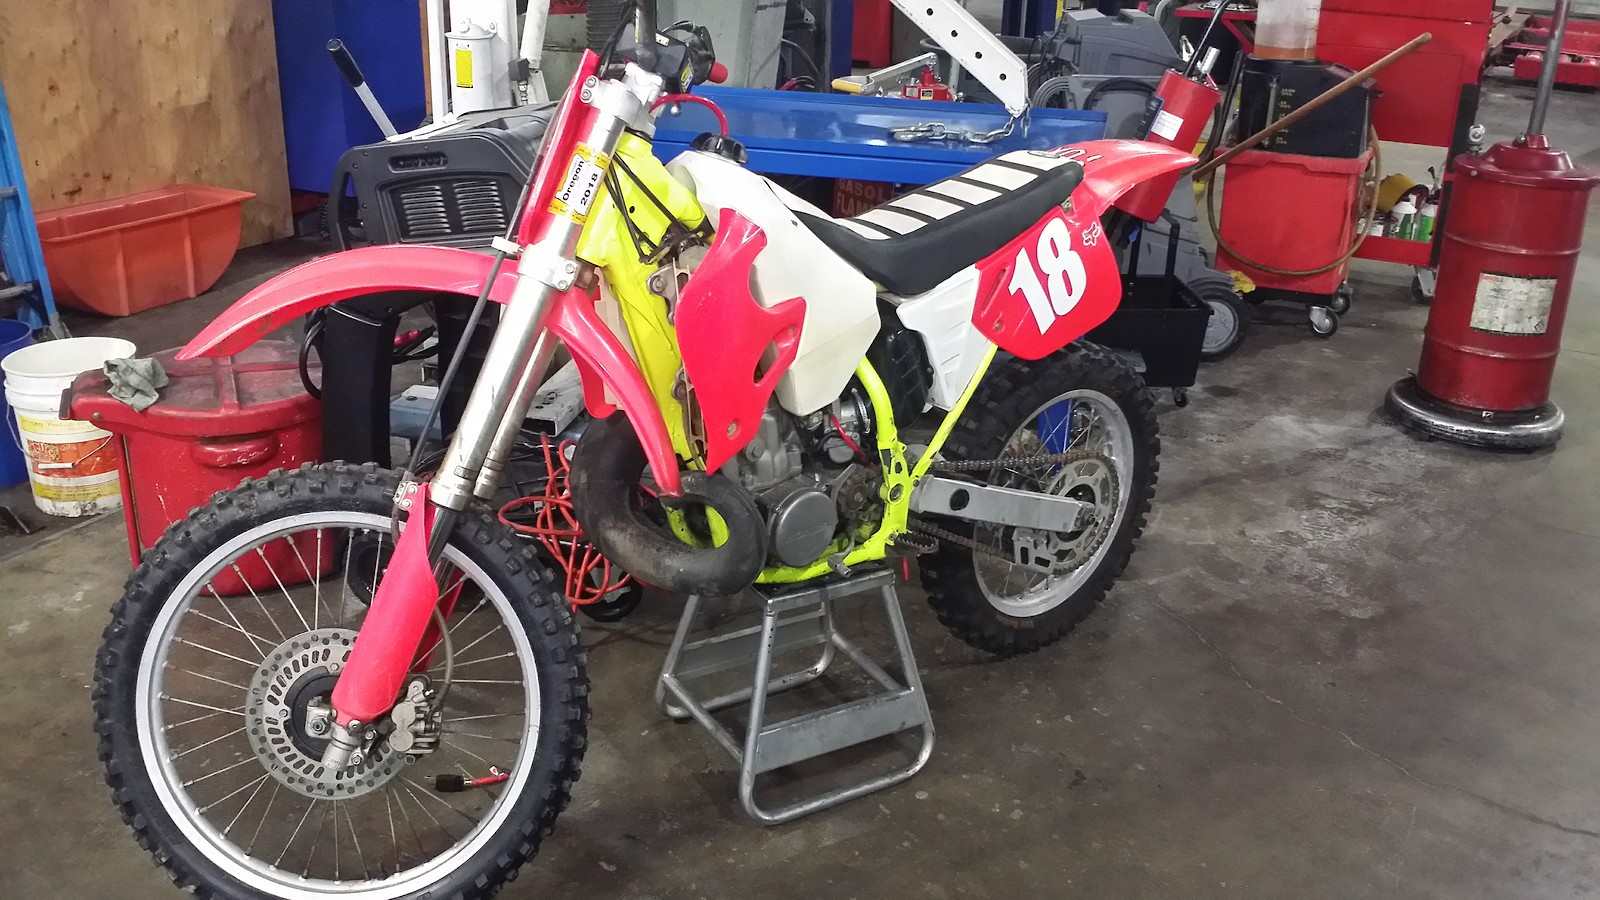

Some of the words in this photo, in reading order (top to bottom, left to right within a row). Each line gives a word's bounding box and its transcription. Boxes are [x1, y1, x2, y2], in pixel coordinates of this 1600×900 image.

[562, 160, 585, 201] Oregon
[580, 173, 598, 206] 2018
[836, 191, 874, 217] FLAM
[1008, 217, 1087, 335] 18
